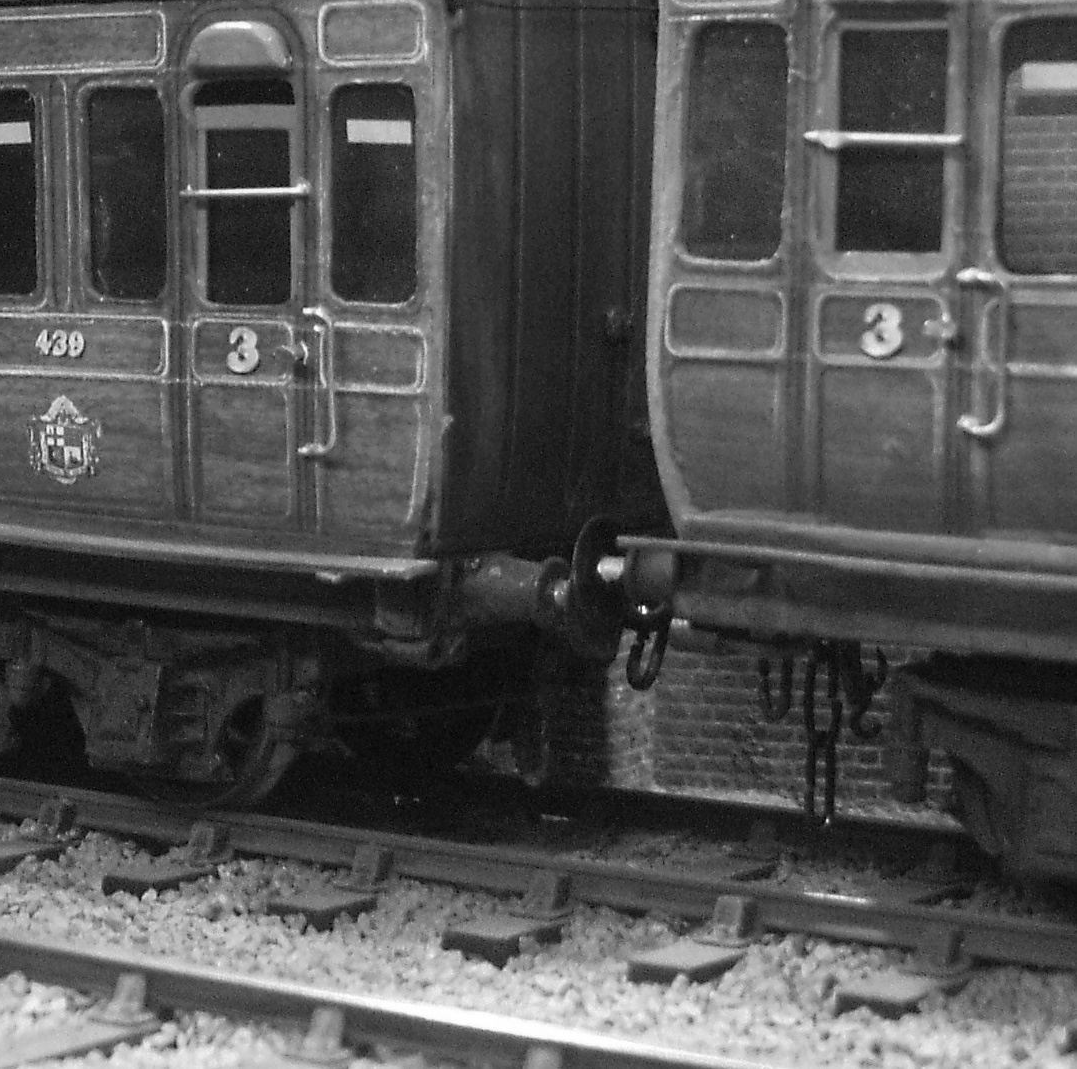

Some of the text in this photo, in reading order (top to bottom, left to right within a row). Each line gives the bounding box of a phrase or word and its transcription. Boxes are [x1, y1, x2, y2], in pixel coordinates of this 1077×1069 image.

[35, 328, 85, 358] 439
[227, 327, 259, 374] 3
[860, 303, 903, 358] 3
